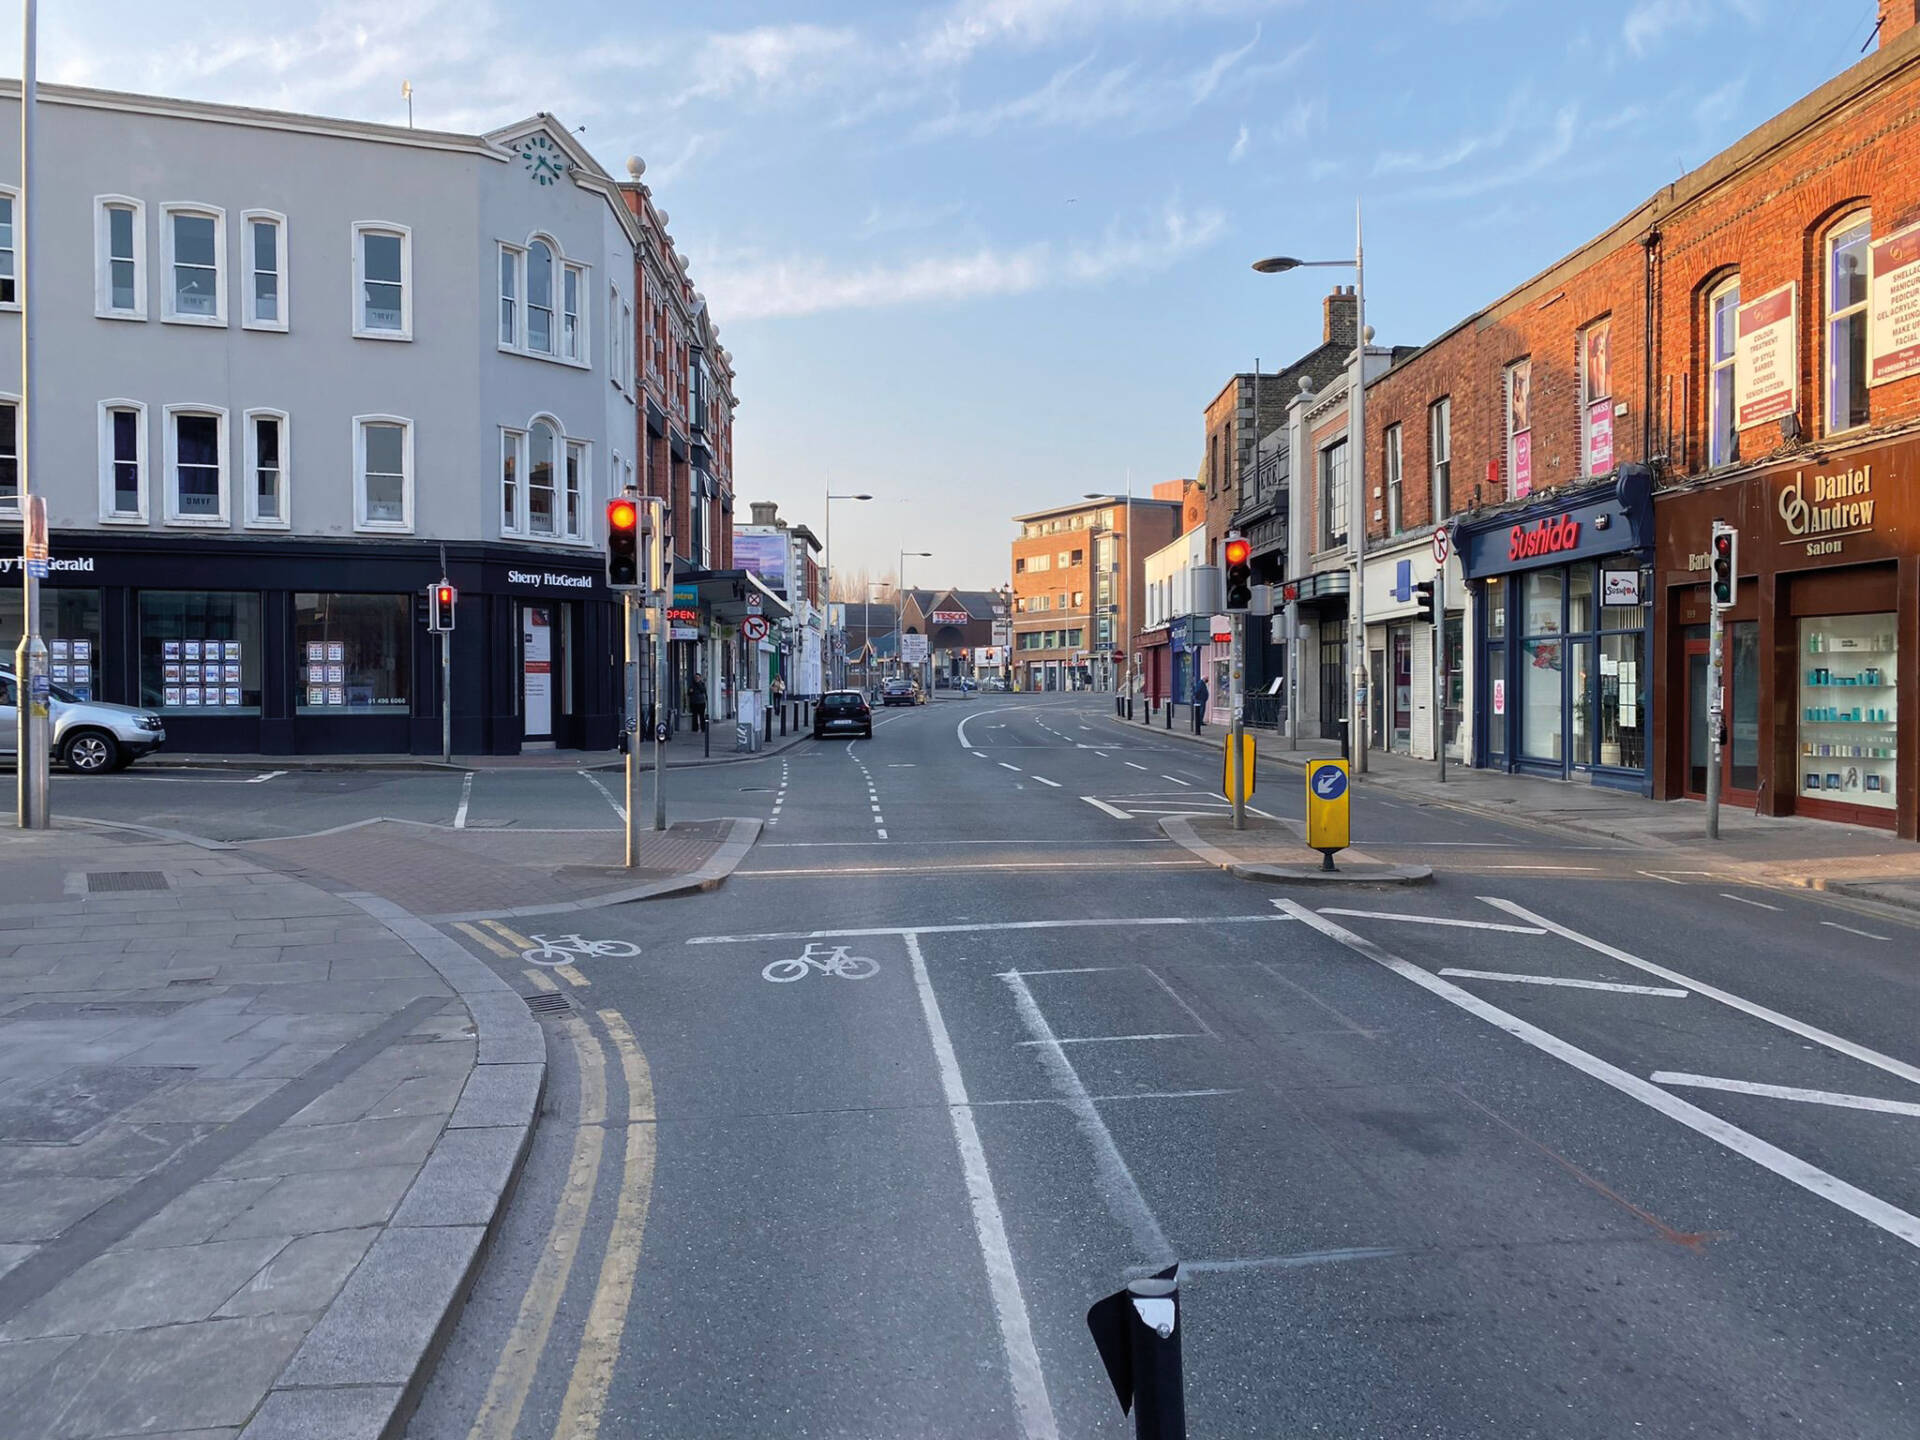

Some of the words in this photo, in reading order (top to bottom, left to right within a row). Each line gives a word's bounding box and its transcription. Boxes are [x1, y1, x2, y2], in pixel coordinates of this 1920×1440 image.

[1815, 465, 1872, 502] Daniel
[1811, 500, 1875, 534] Andrew
[1508, 513, 1579, 561] Sushida
[17, 556, 95, 572] FGerald
[1688, 552, 1711, 572] Barb
[508, 570, 541, 588] Sherry
[543, 573, 592, 588] FitzGerald
[666, 610, 696, 620] OPEN
[934, 611, 967, 621] TESCO
